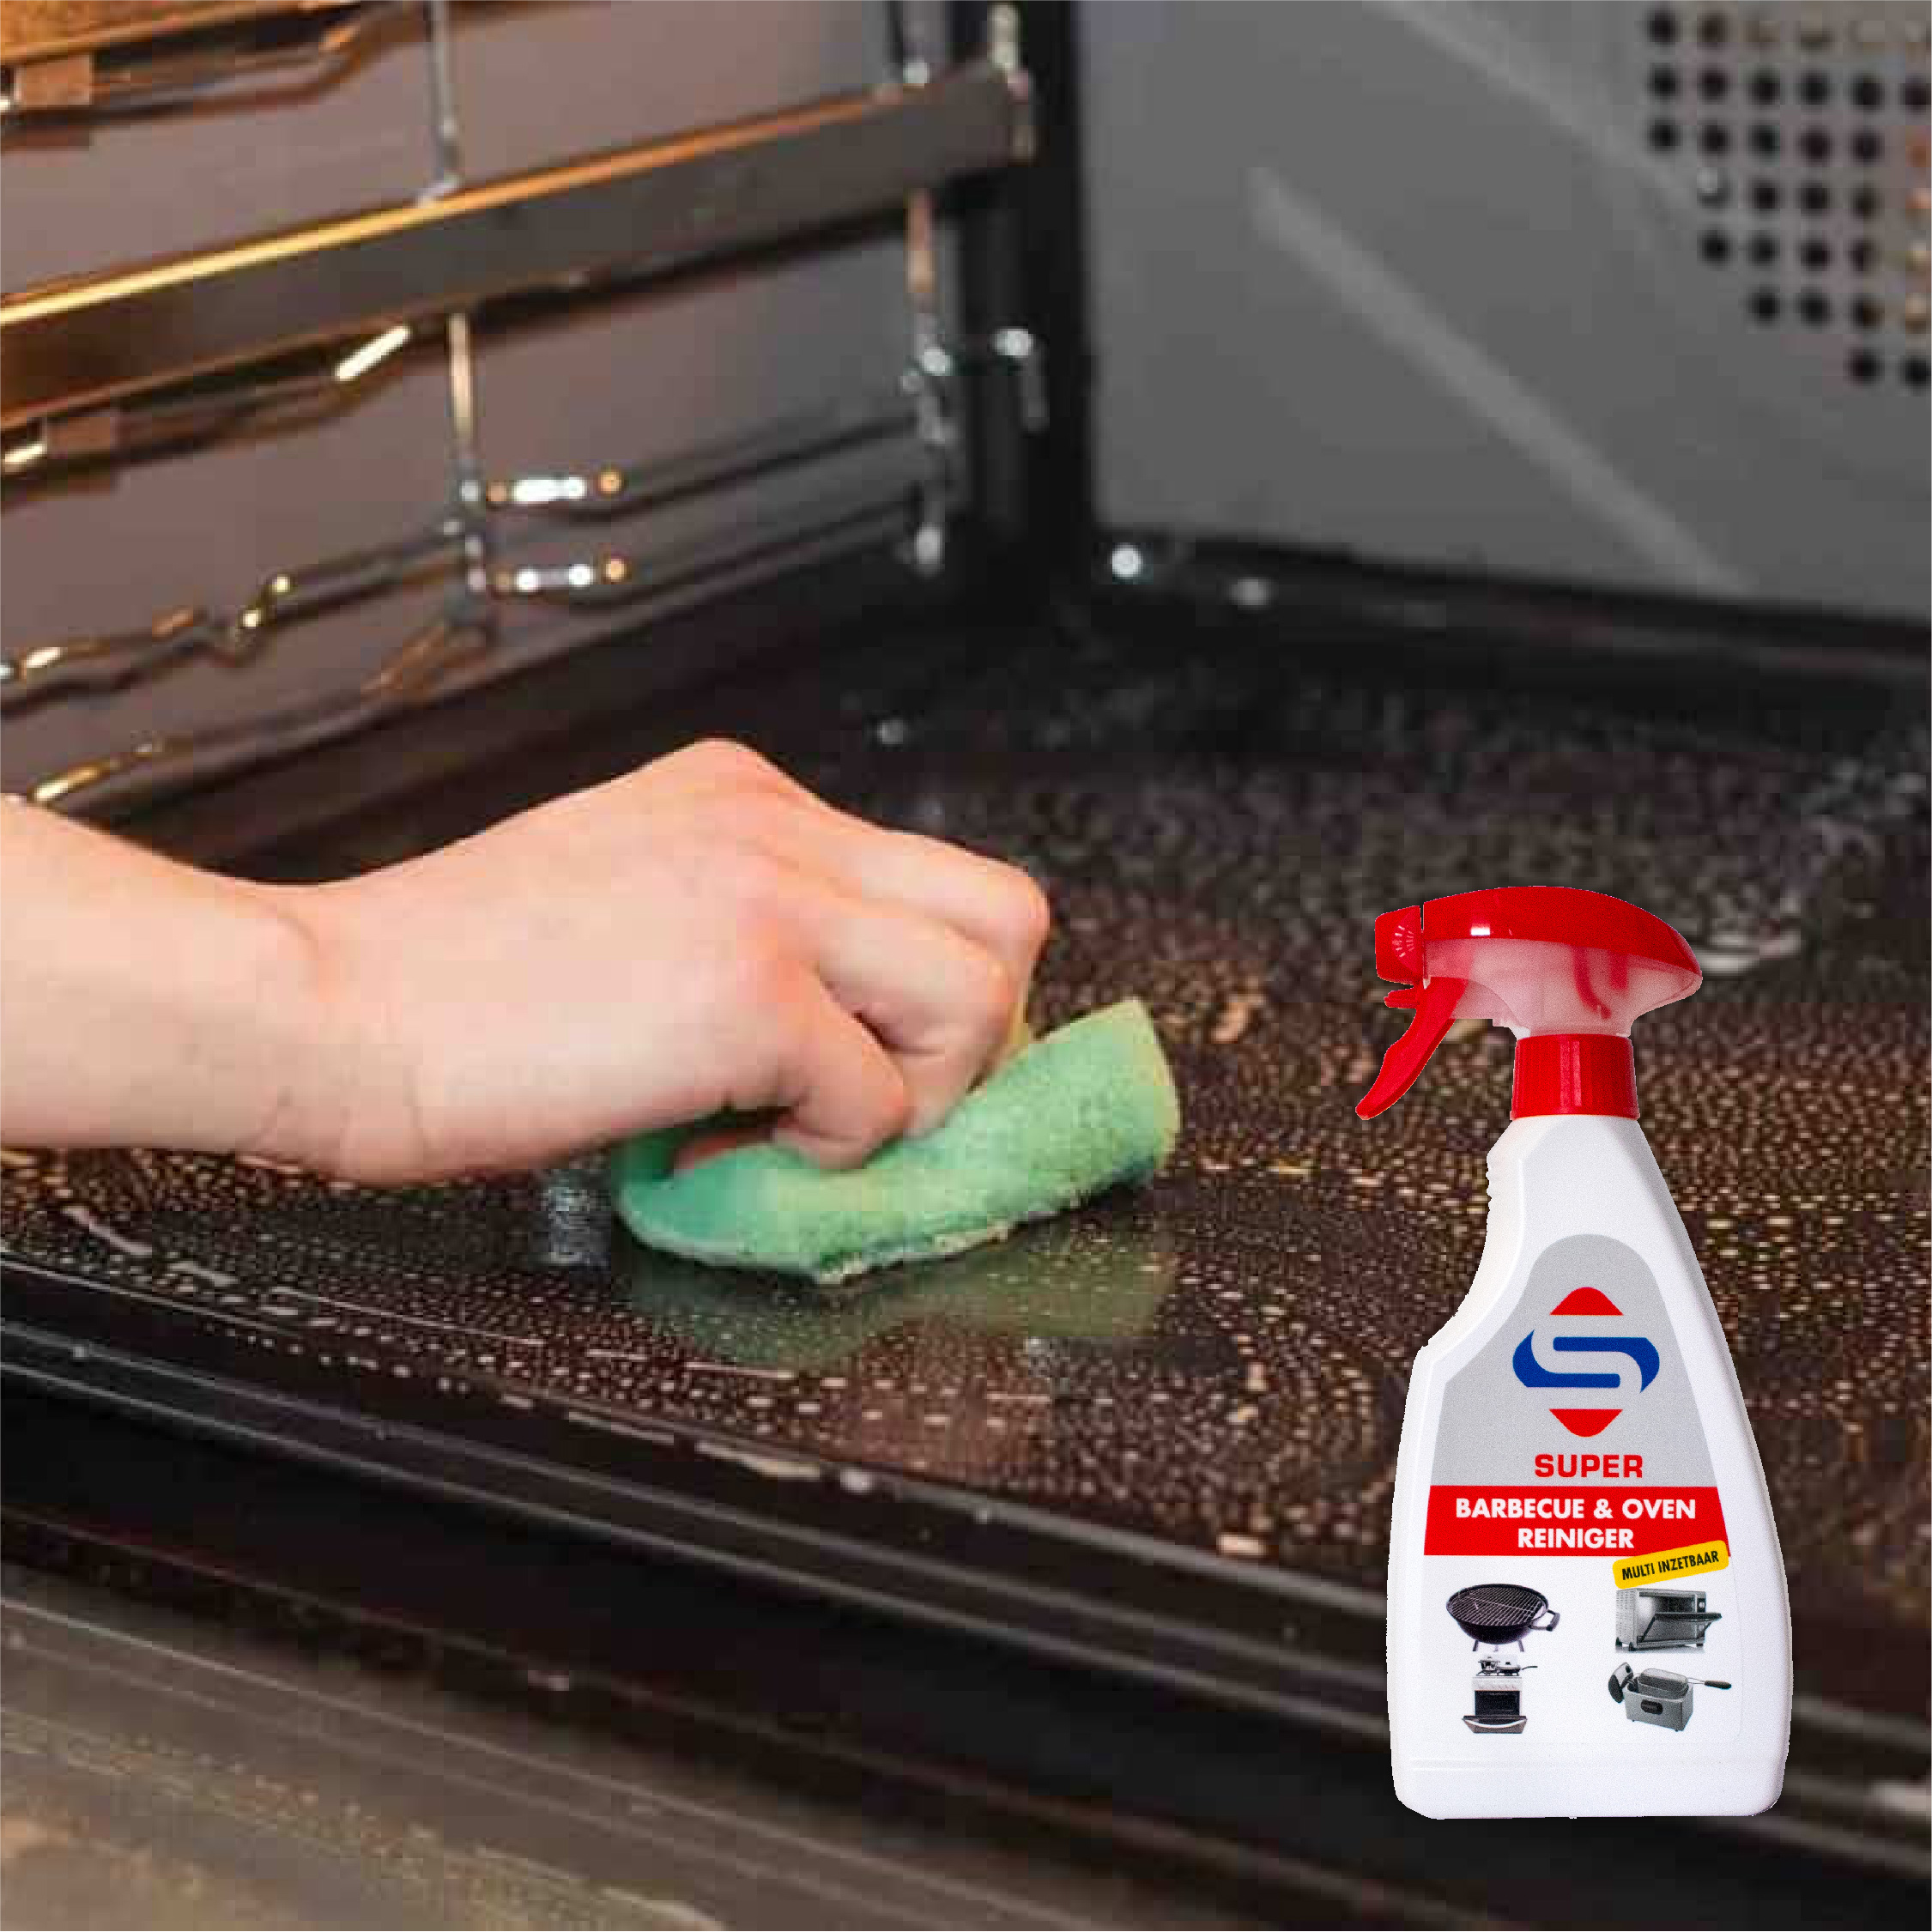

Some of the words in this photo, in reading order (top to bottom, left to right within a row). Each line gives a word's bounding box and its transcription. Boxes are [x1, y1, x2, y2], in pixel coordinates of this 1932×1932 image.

[1535, 1454, 1644, 1478] SUPER
[1456, 1498, 1585, 1518] BARBECUE
[1594, 1498, 1613, 1518] &
[1622, 1499, 1696, 1519] OVEN
[1517, 1528, 1634, 1549] REINIGER
[1621, 1563, 1656, 1581] MULTI
[1657, 1549, 1720, 1572] INZETBAAR
